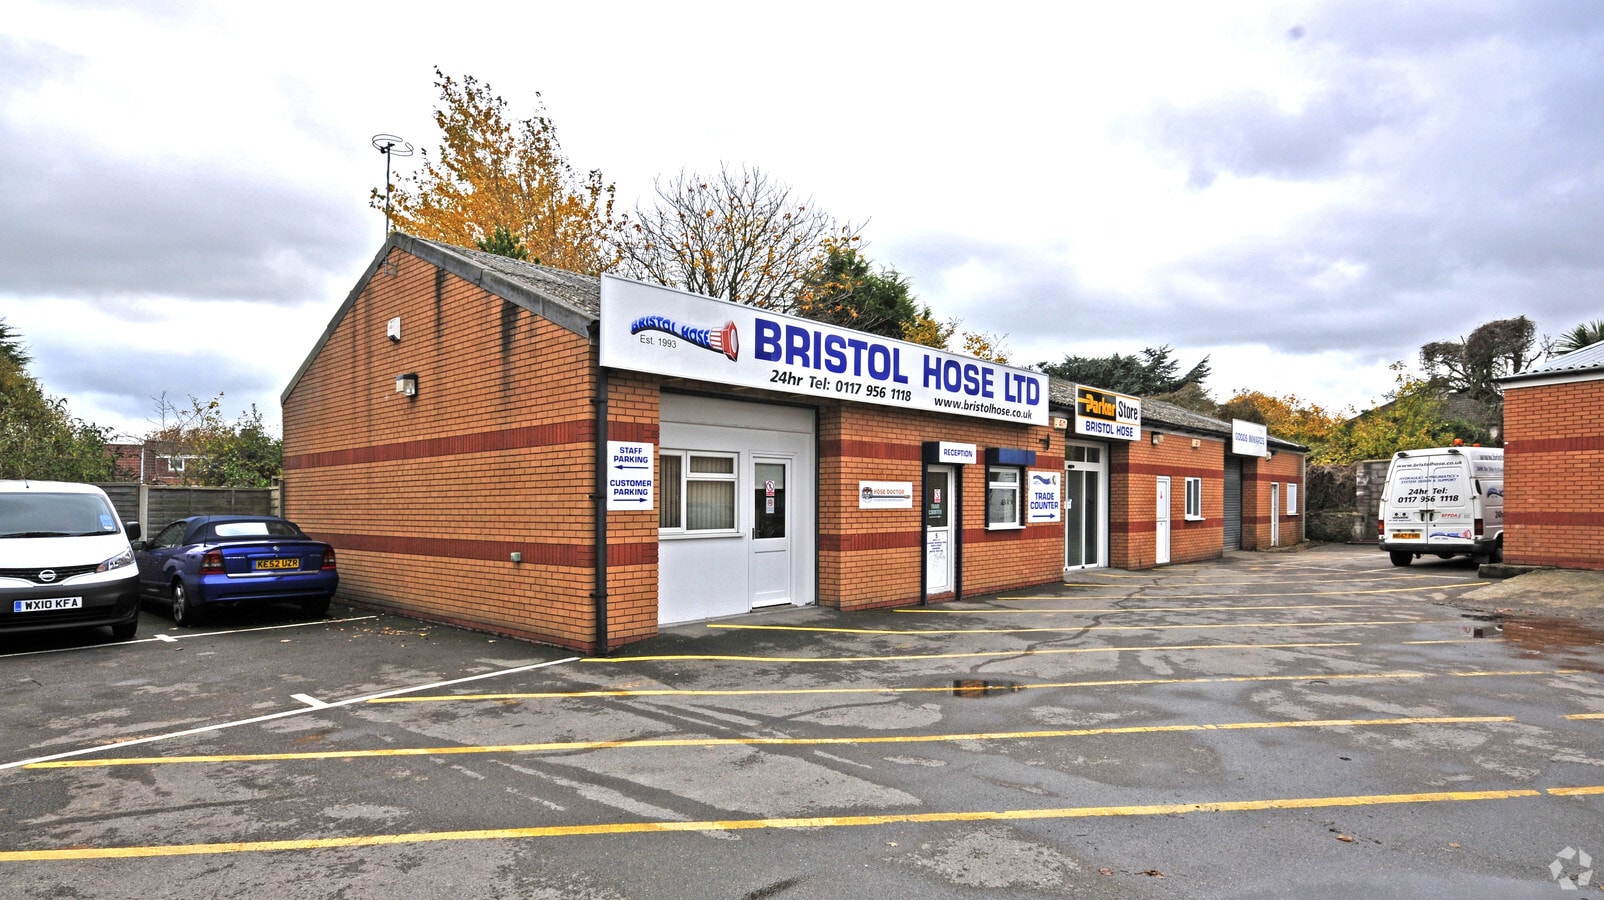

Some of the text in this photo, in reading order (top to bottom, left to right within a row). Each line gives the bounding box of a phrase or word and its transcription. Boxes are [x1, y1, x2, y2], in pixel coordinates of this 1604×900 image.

[631, 315, 711, 347] BRISTOL HOSE
[640, 334, 677, 349] Est. 1993
[755, 318, 1040, 405] BRISTOL HOSE LTD
[770, 369, 912, 402] 24hr Tel: 0117 956 1118
[934, 397, 1033, 420] www.bristolhose.co.uk
[1085, 393, 1138, 420] Parker Store
[1085, 420, 1134, 437] BRISTOL HOSE
[1235, 432, 1248, 442] GOODS
[943, 448, 973, 458] RECEPTION
[613, 455, 649, 464] PARKING
[613, 488, 649, 496] PARKING
[1035, 492, 1055, 501] TRADE
[1408, 487, 1448, 496] 24hr Tel:
[1397, 496, 1417, 504] 0117
[1030, 501, 1058, 510] COUNTER
[257, 559, 298, 568] KE52 UZR
[25, 598, 79, 610] WX10 KFA
